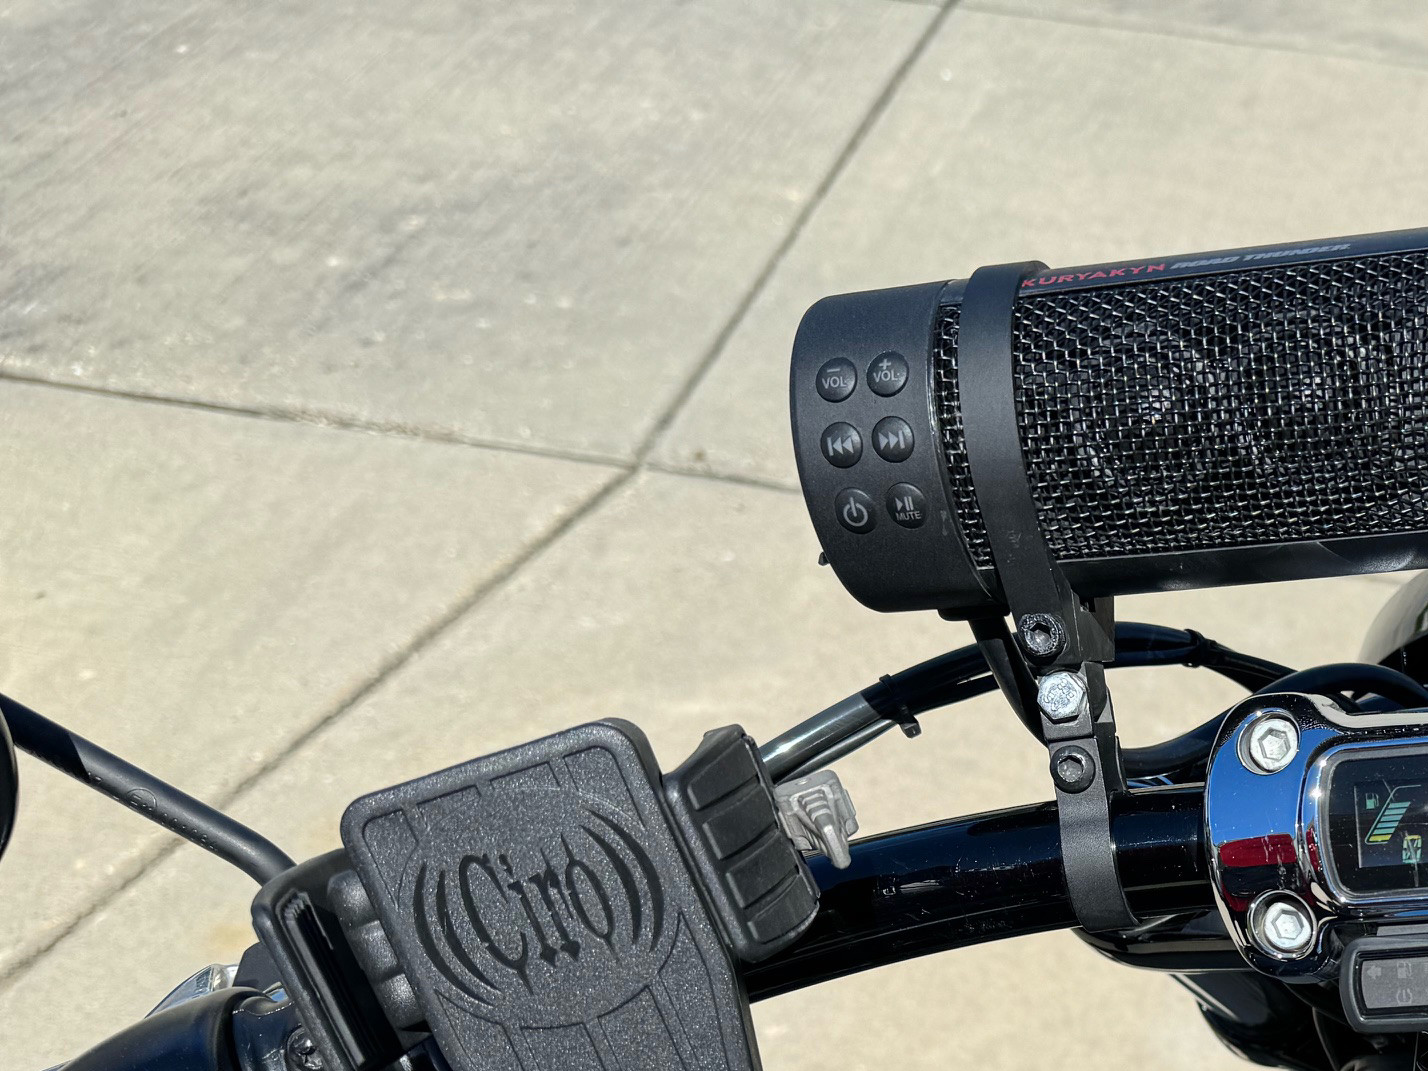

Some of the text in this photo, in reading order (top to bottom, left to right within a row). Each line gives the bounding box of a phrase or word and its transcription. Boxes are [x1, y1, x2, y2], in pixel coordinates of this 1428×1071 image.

[1021, 263, 1166, 288] KURYAKYN
[822, 376, 847, 389] VOL
[873, 370, 898, 383] VOL
[895, 510, 922, 521] MUTE
[459, 833, 619, 996] Ciro
